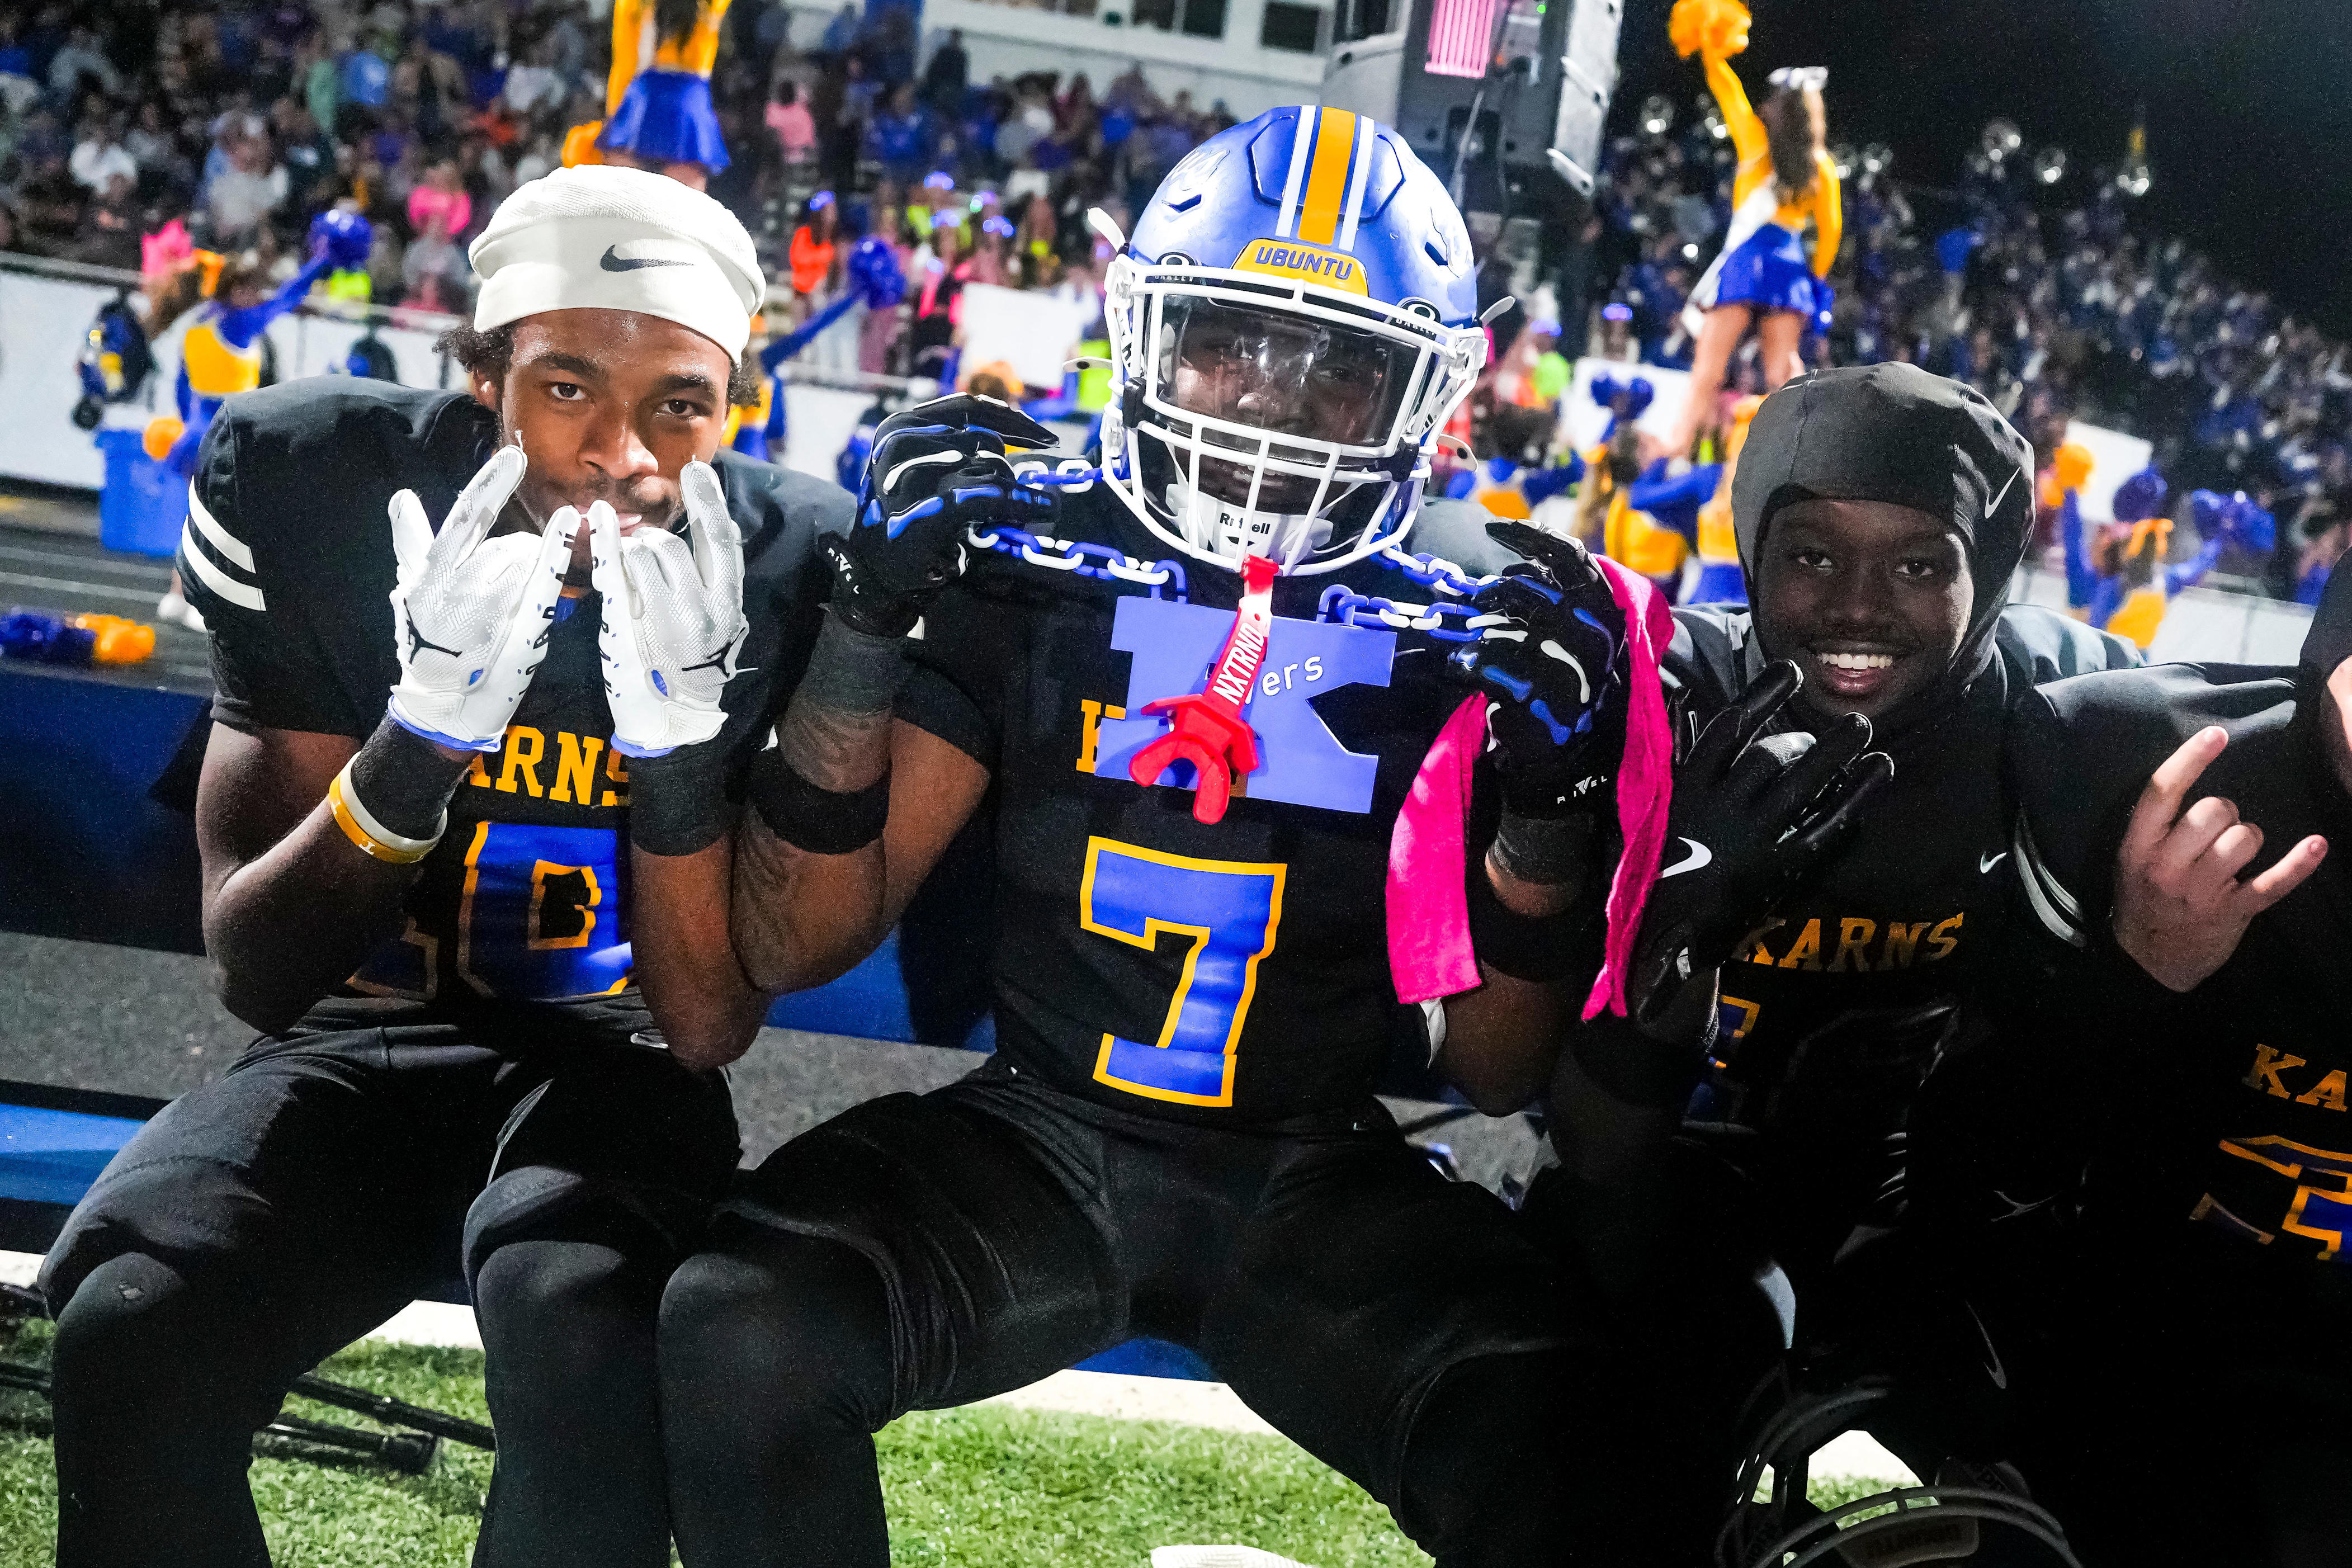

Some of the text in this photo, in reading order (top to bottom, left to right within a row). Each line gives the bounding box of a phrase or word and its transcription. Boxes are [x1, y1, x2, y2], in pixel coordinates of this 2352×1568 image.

[1255, 246, 1353, 280] UBUNTU
[1220, 512, 1271, 535] Riell
[1212, 622, 1264, 706] NXTRND
[1245, 656, 1324, 704] ers
[1730, 912, 1964, 974] KARNS
[1080, 835, 1288, 1107] 7
